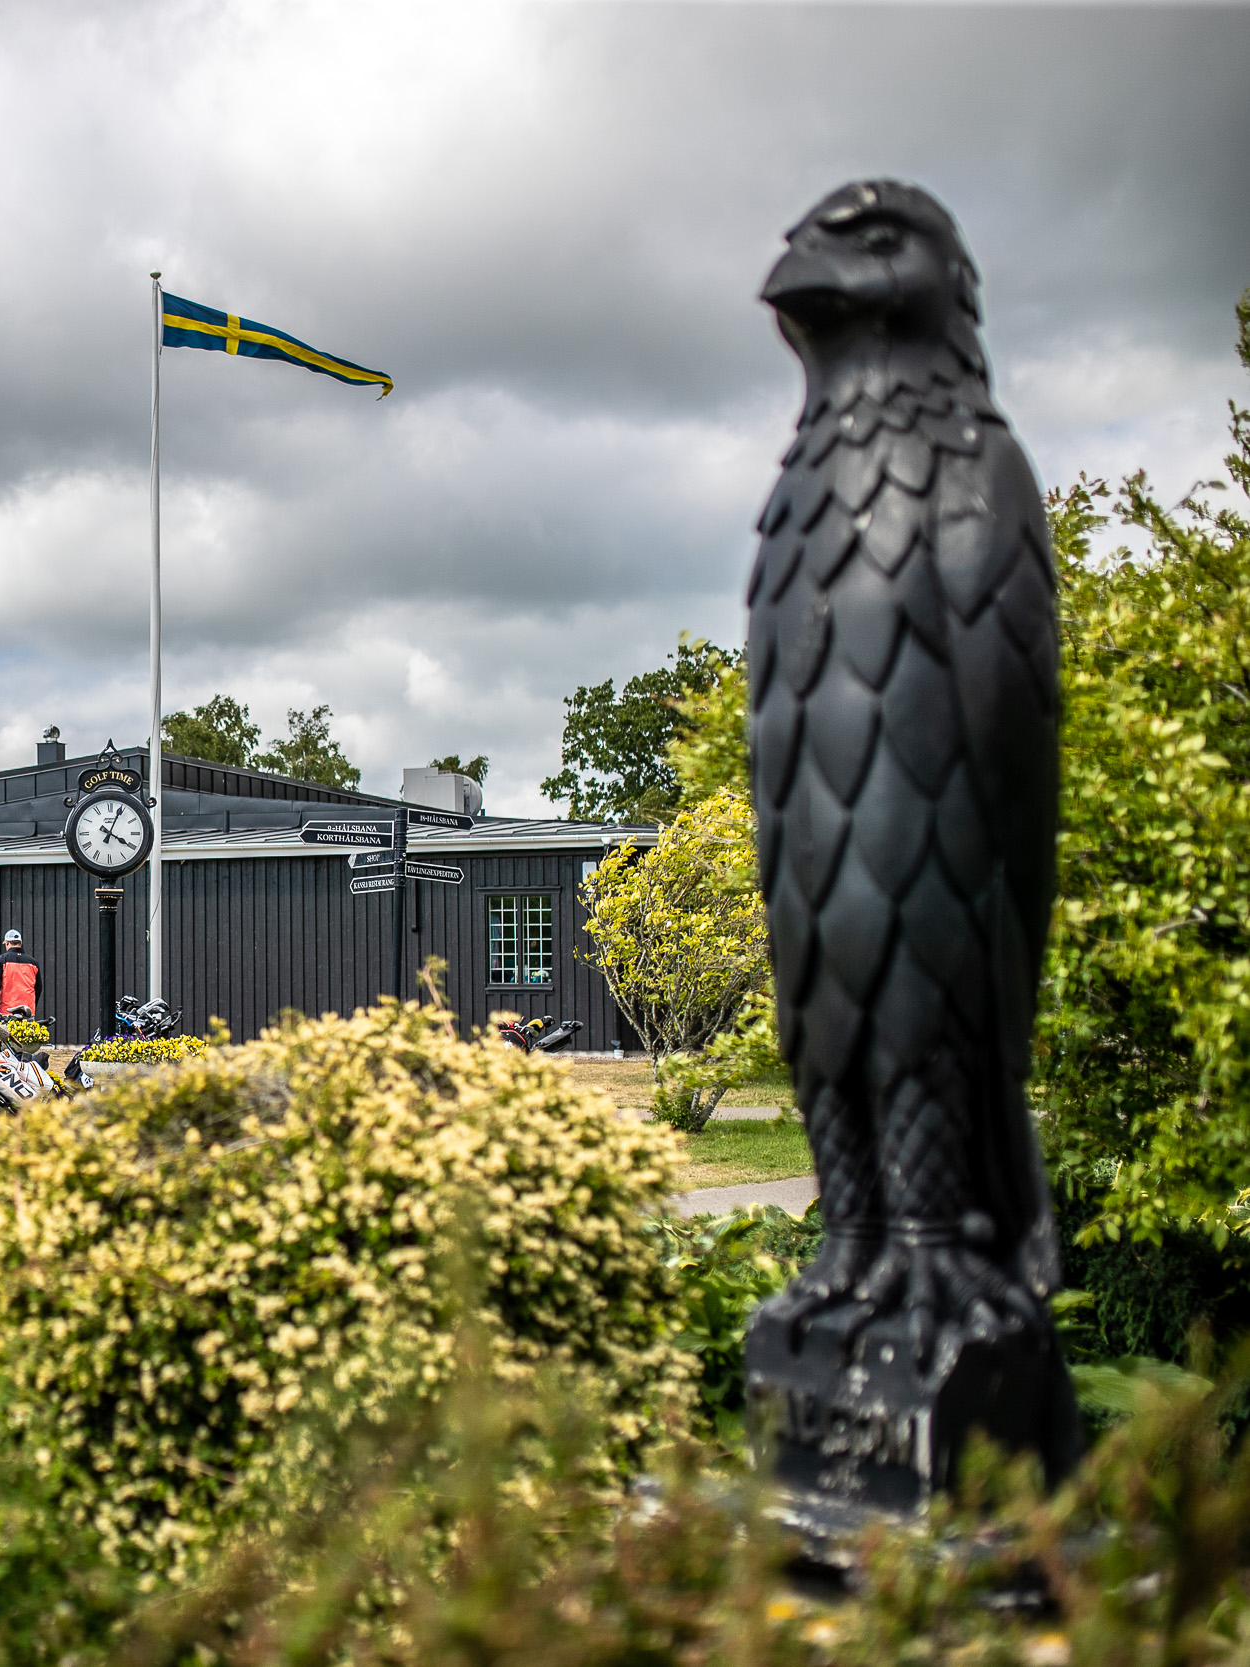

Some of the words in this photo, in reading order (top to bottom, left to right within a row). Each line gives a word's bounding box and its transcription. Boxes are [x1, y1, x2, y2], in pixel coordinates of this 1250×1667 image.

[84, 771, 108, 789] GOLF
[110, 771, 134, 786] TIME
[420, 815, 459, 826] 18-HÅLSBANA
[317, 834, 381, 844] KORTHÅLSBANA
[366, 854, 380, 863] SHOP
[407, 865, 459, 879] TÄVLINGSEXPEDITION
